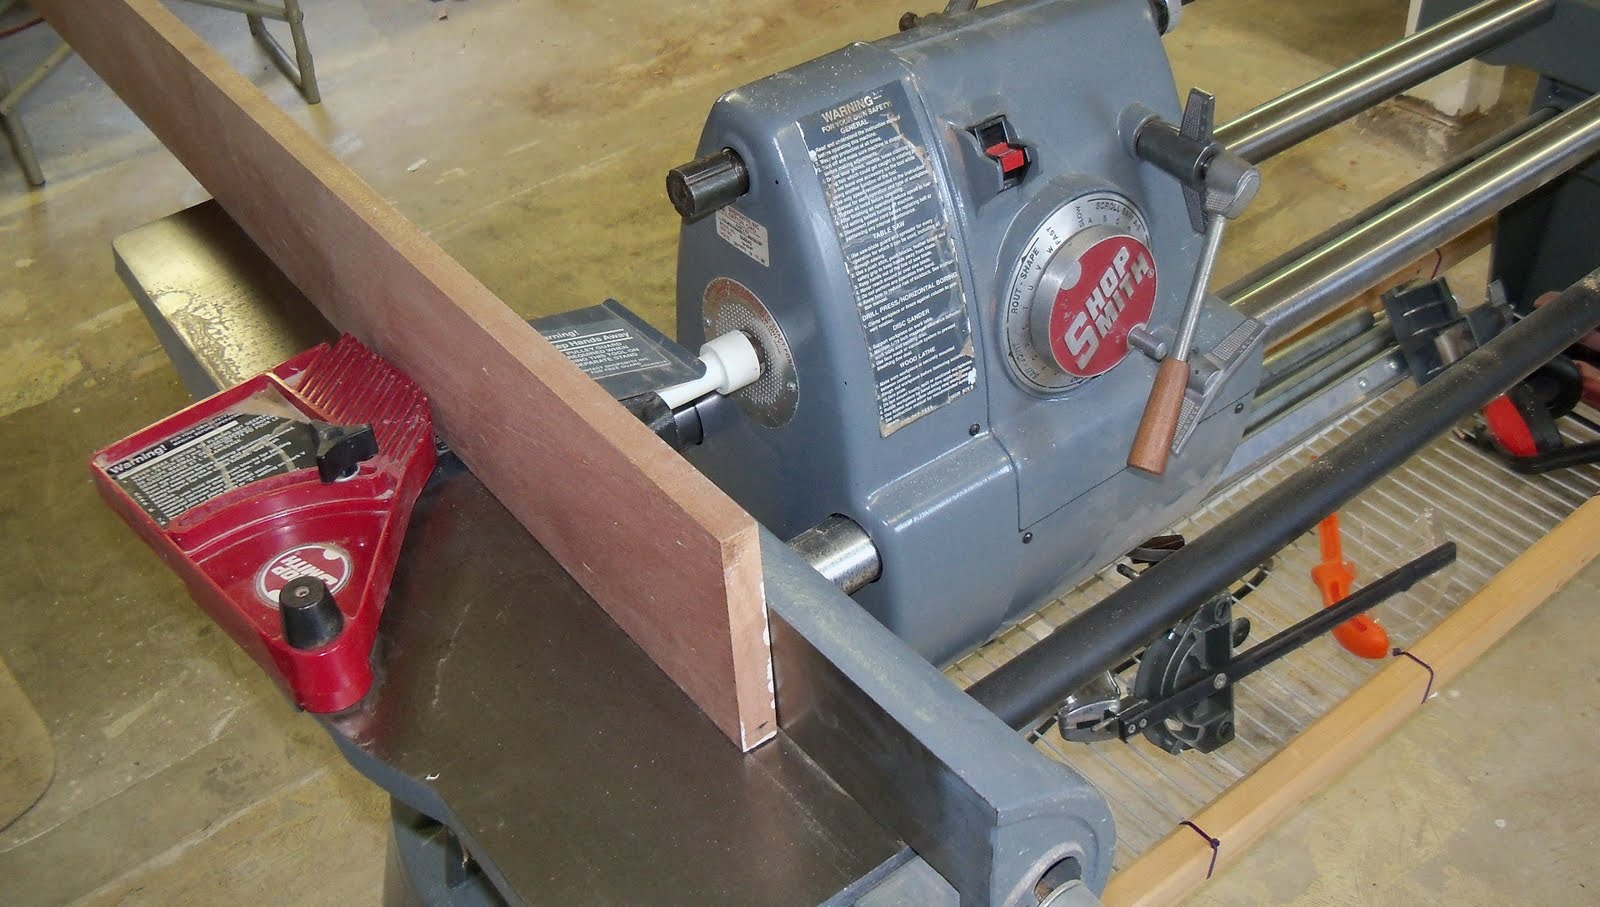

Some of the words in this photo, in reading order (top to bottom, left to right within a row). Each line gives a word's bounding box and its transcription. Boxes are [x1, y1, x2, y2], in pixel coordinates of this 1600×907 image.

[820, 94, 874, 124] WARNING
[820, 122, 835, 133] FOR
[852, 110, 867, 120] OWN
[839, 117, 869, 134] GENERAL
[1096, 202, 1120, 213] SCROLL
[872, 226, 891, 239] TABLE
[891, 220, 905, 231] SAW
[1046, 226, 1062, 246] FAST
[1046, 246, 1054, 254] W
[1011, 288, 1022, 315] ROUT
[1020, 247, 1040, 280] SHAPE
[861, 308, 879, 322] DRILL
[935, 270, 957, 286] BORING
[892, 319, 906, 331] DISC
[906, 307, 930, 324] SANDER
[543, 328, 580, 342] rning!
[554, 342, 571, 351] ep
[568, 334, 602, 347] Hands
[601, 329, 631, 342] Away
[565, 345, 595, 356] PULLEY
[594, 340, 622, 351] GUARD
[604, 343, 629, 353] WHEN
[606, 348, 628, 357] TOOL
[612, 351, 639, 361] STAND
[899, 355, 917, 369] WOOD
[917, 345, 935, 360] LATHE
[109, 442, 170, 477] Warning!
